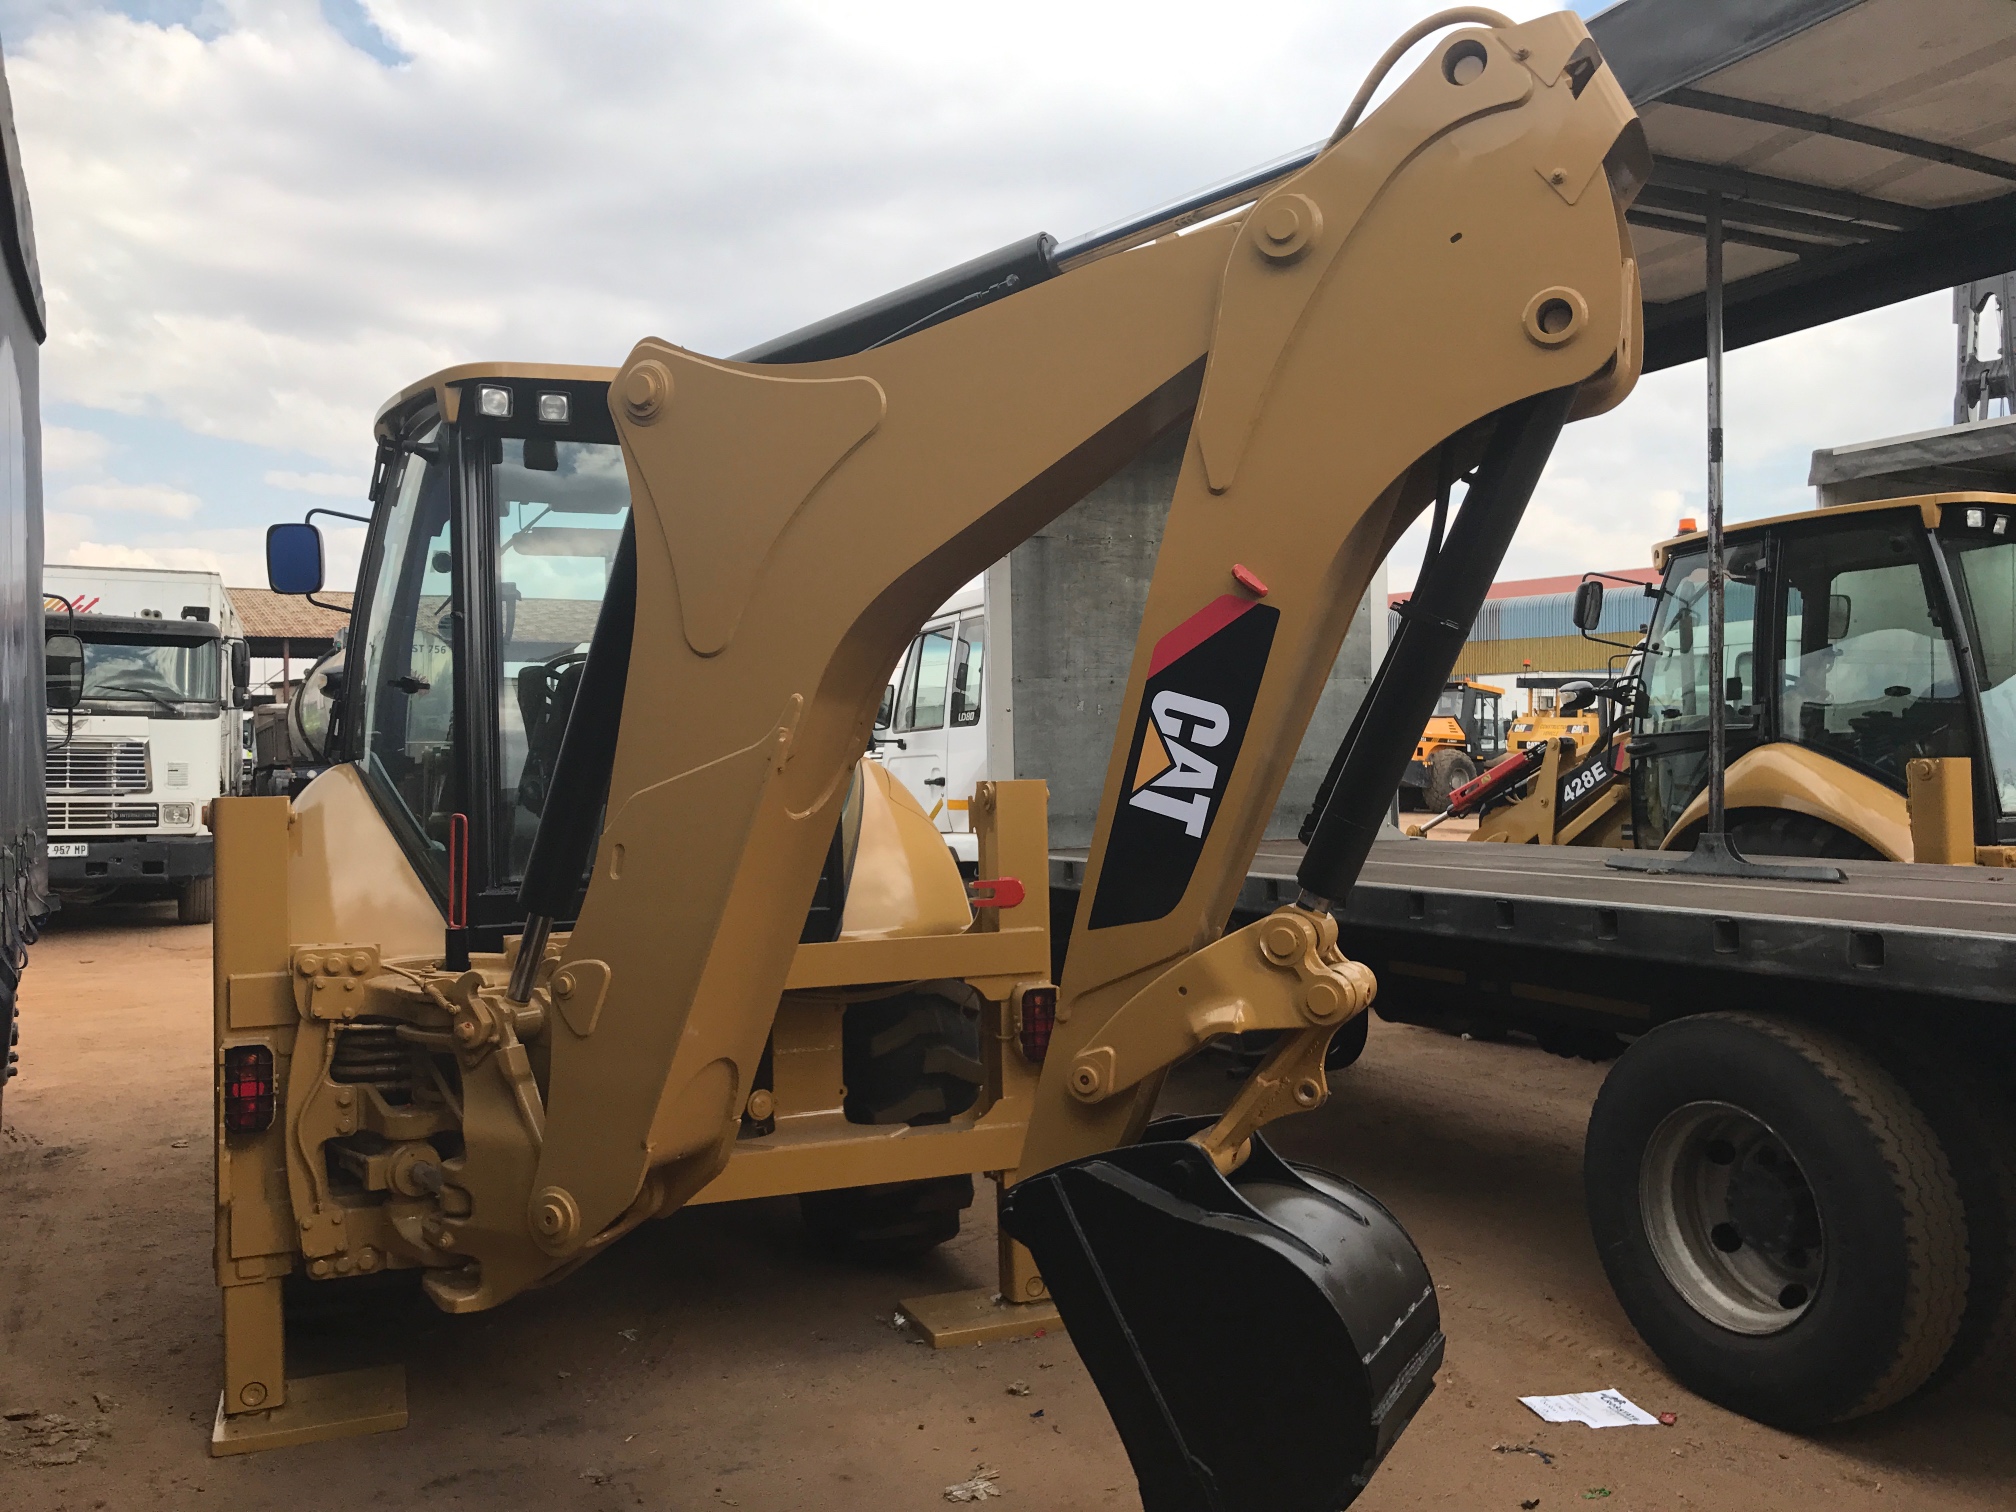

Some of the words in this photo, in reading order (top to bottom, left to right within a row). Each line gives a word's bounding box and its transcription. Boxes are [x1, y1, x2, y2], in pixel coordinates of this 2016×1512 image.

[428, 645, 447, 655] 756
[1514, 724, 1527, 733] CAT
[1571, 725, 1585, 734] CAT
[1128, 690, 1230, 839] CAT
[1564, 761, 1607, 802] 428E
[53, 845, 71, 855] 957
[74, 845, 86, 855] MP
